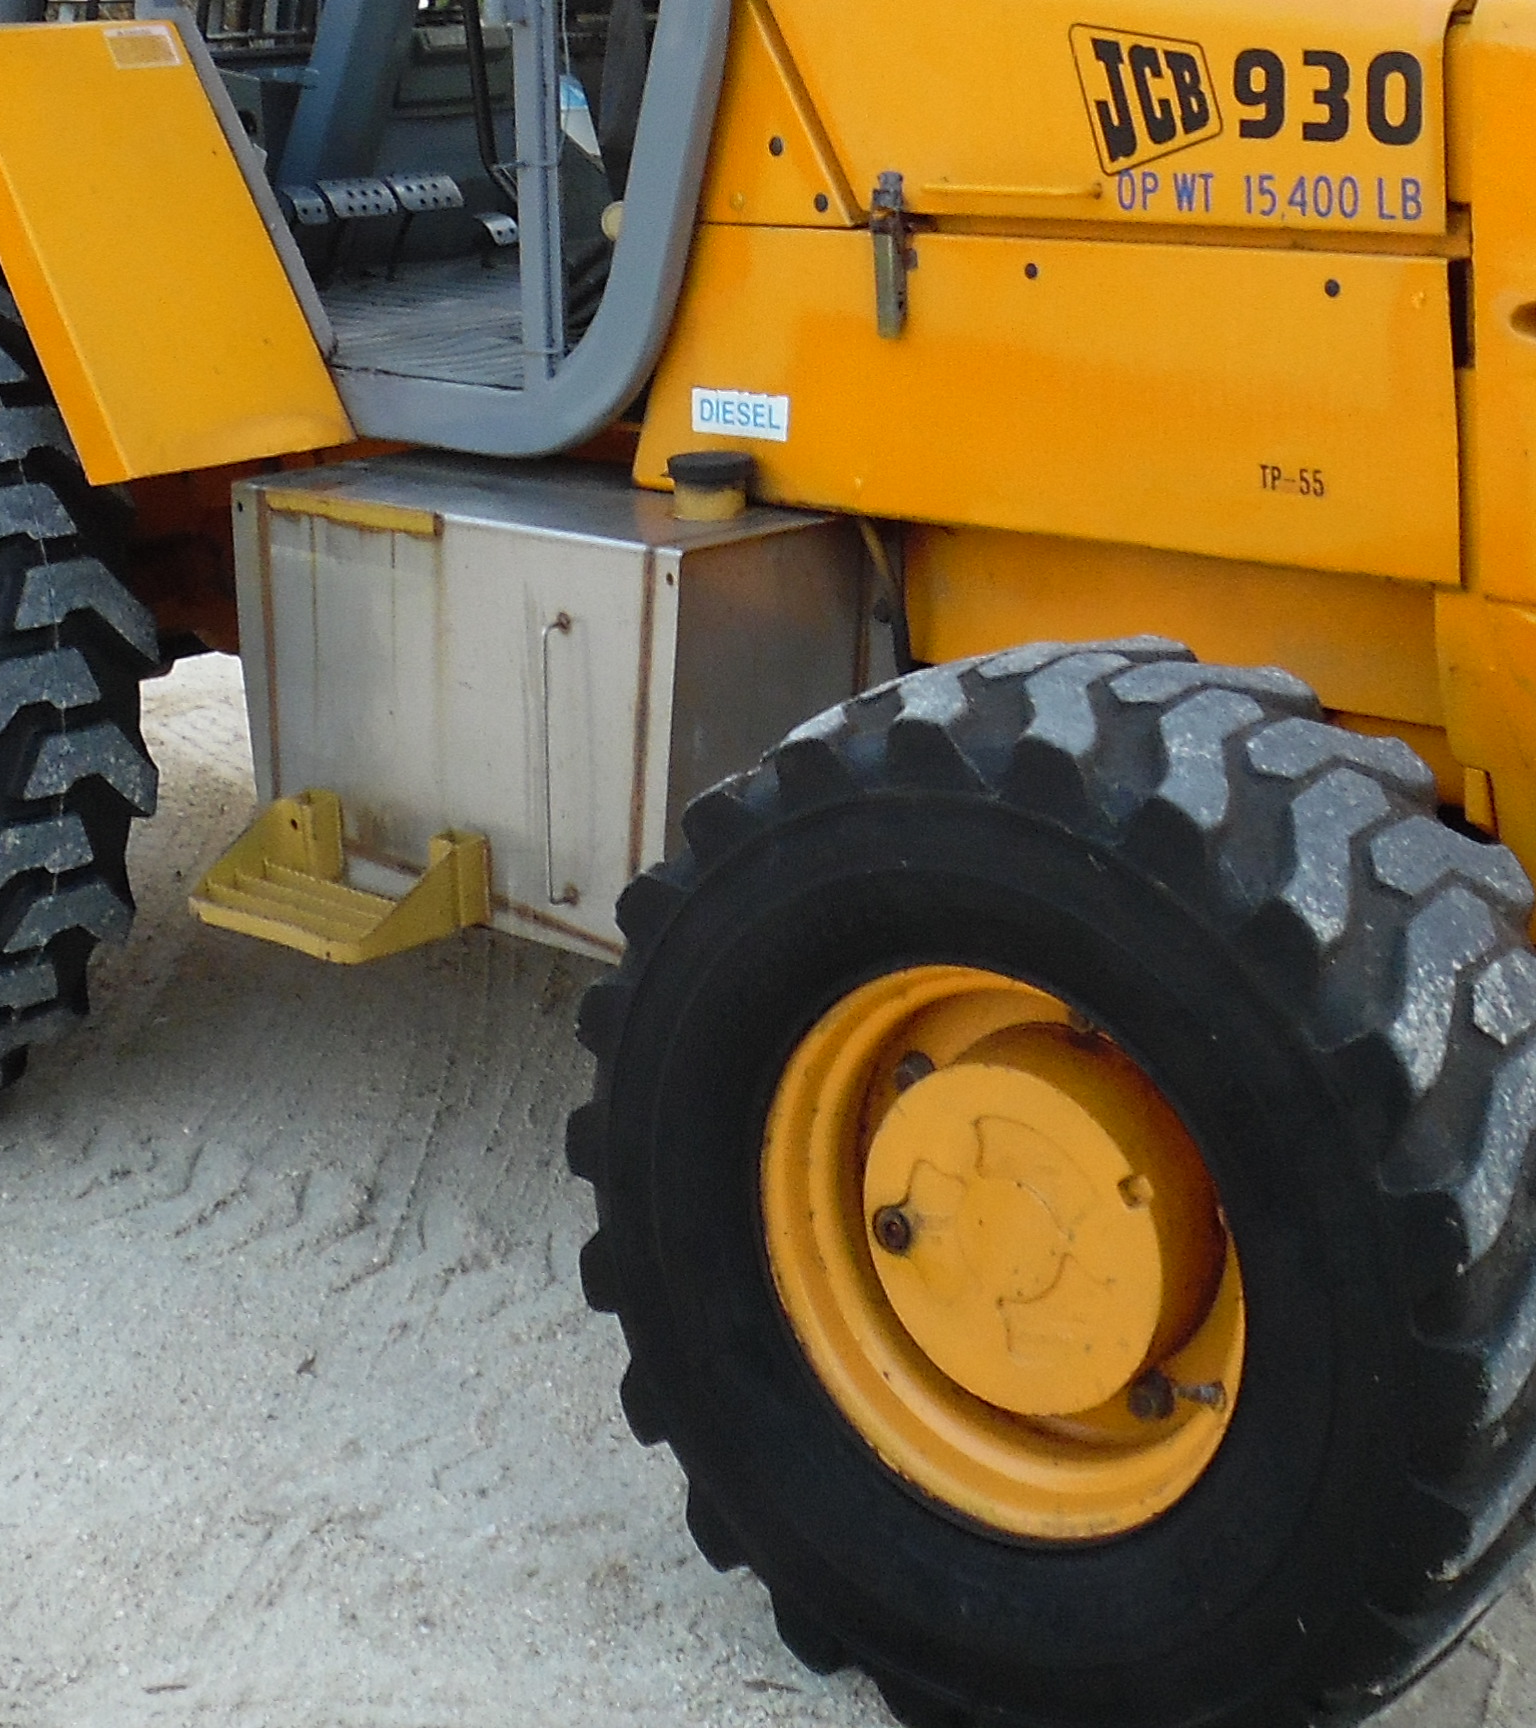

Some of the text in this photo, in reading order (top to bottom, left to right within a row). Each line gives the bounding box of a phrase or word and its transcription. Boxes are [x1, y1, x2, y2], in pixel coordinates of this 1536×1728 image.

[1090, 37, 1424, 163] JCB 930
[1116, 169, 1424, 222] OP WT 15,400 LB
[699, 397, 781, 431] DIESEL
[1259, 463, 1325, 497] TP-55
